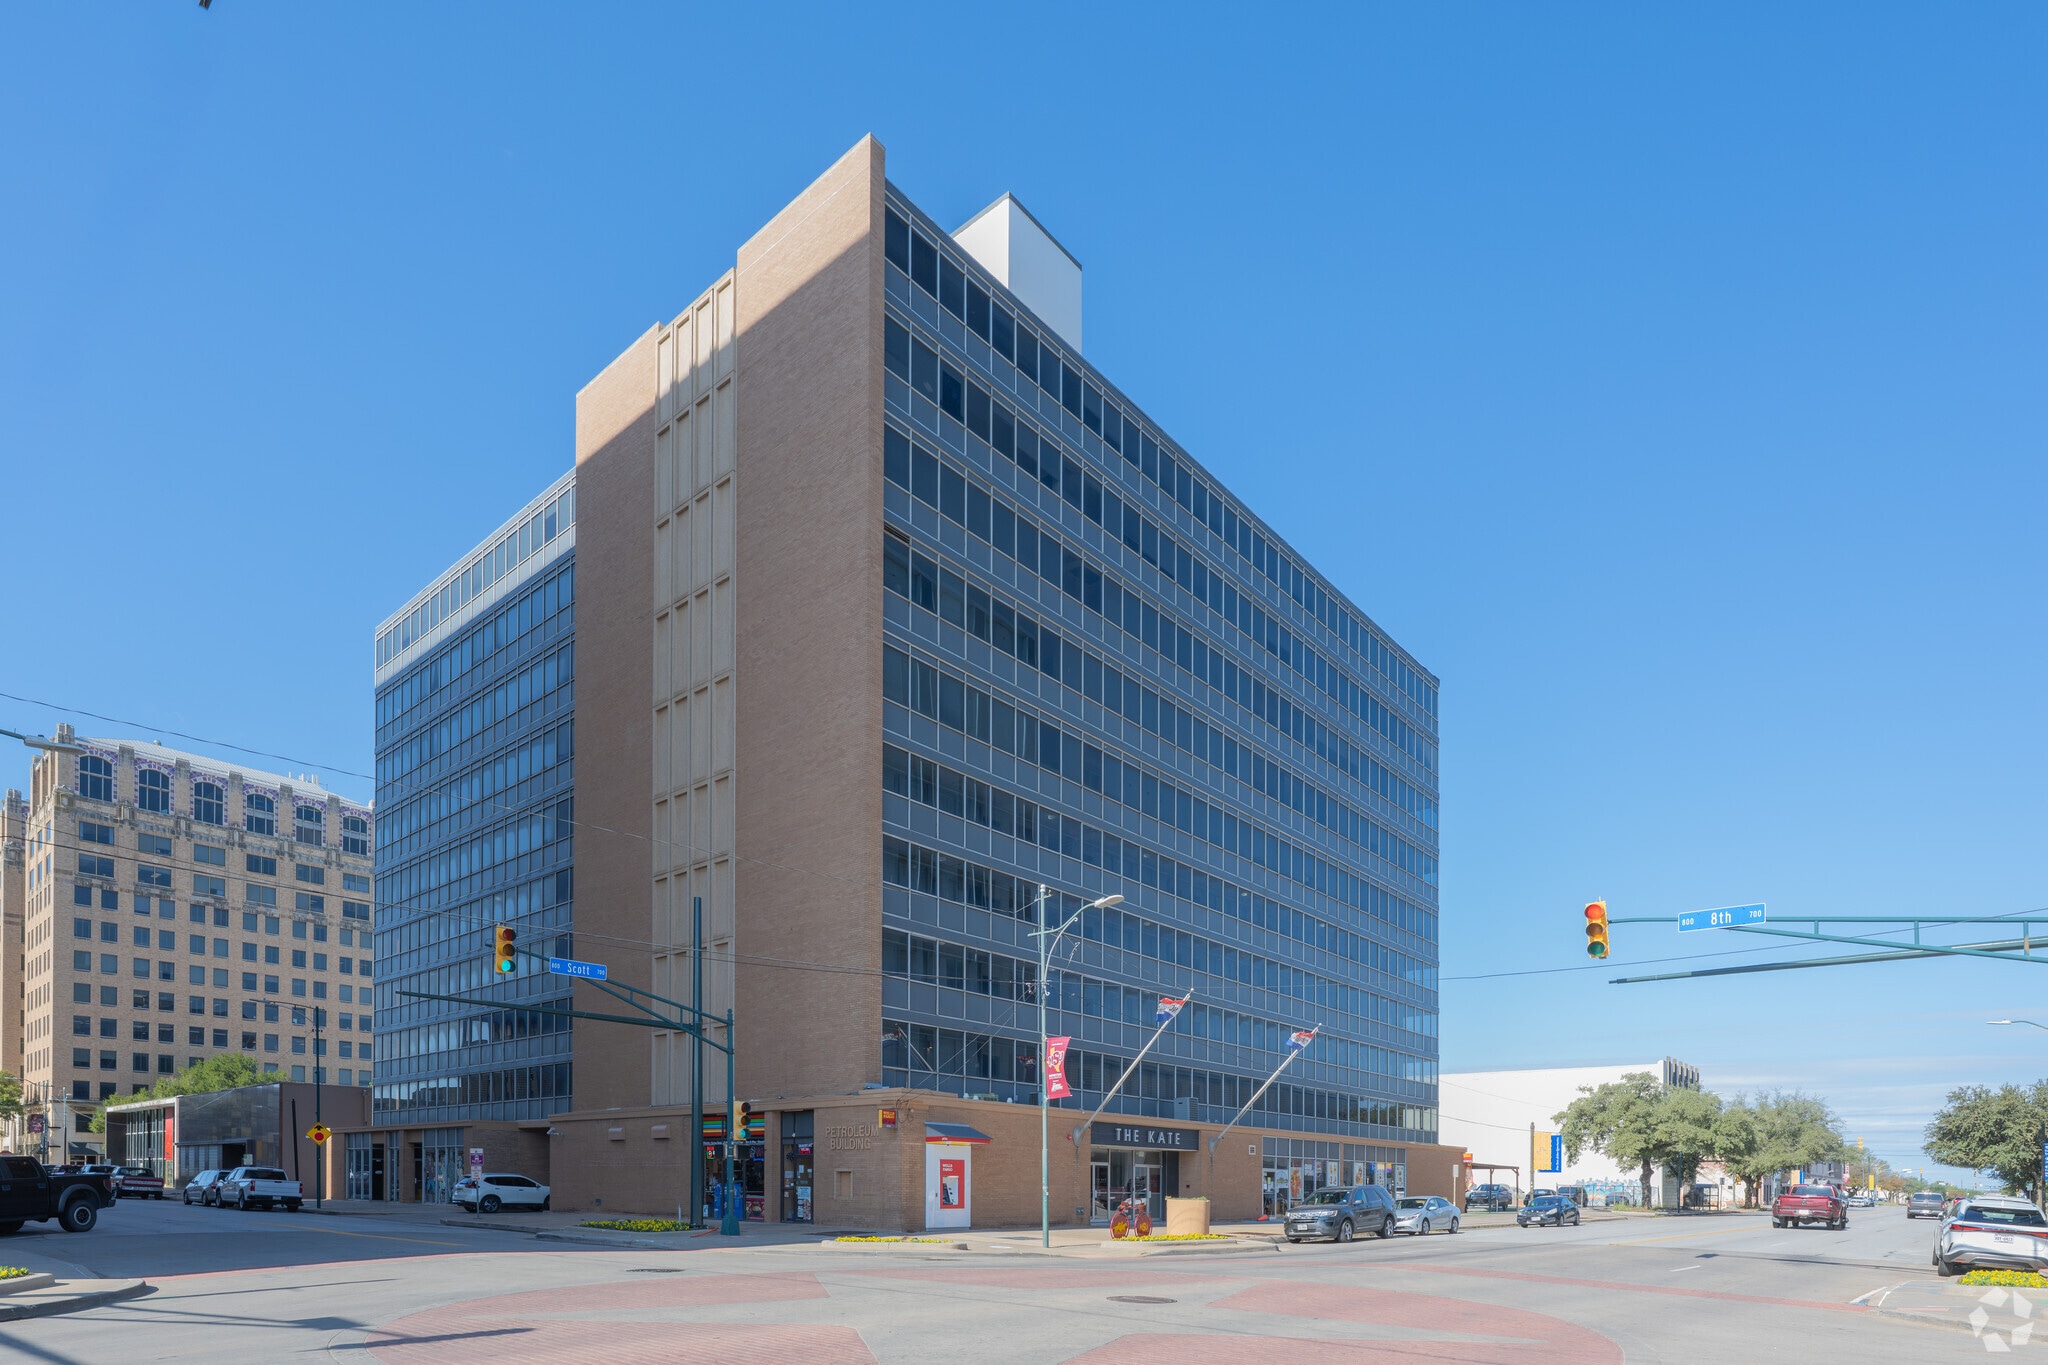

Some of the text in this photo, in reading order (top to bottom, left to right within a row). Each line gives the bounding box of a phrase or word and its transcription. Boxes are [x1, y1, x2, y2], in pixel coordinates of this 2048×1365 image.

[1681, 909, 1762, 927] 800 8th 700
[567, 962, 590, 976] Scott
[825, 1124, 879, 1138] PETROLEUM
[1115, 1127, 1180, 1145] THE KATE
[830, 1138, 871, 1151] BUILDING
